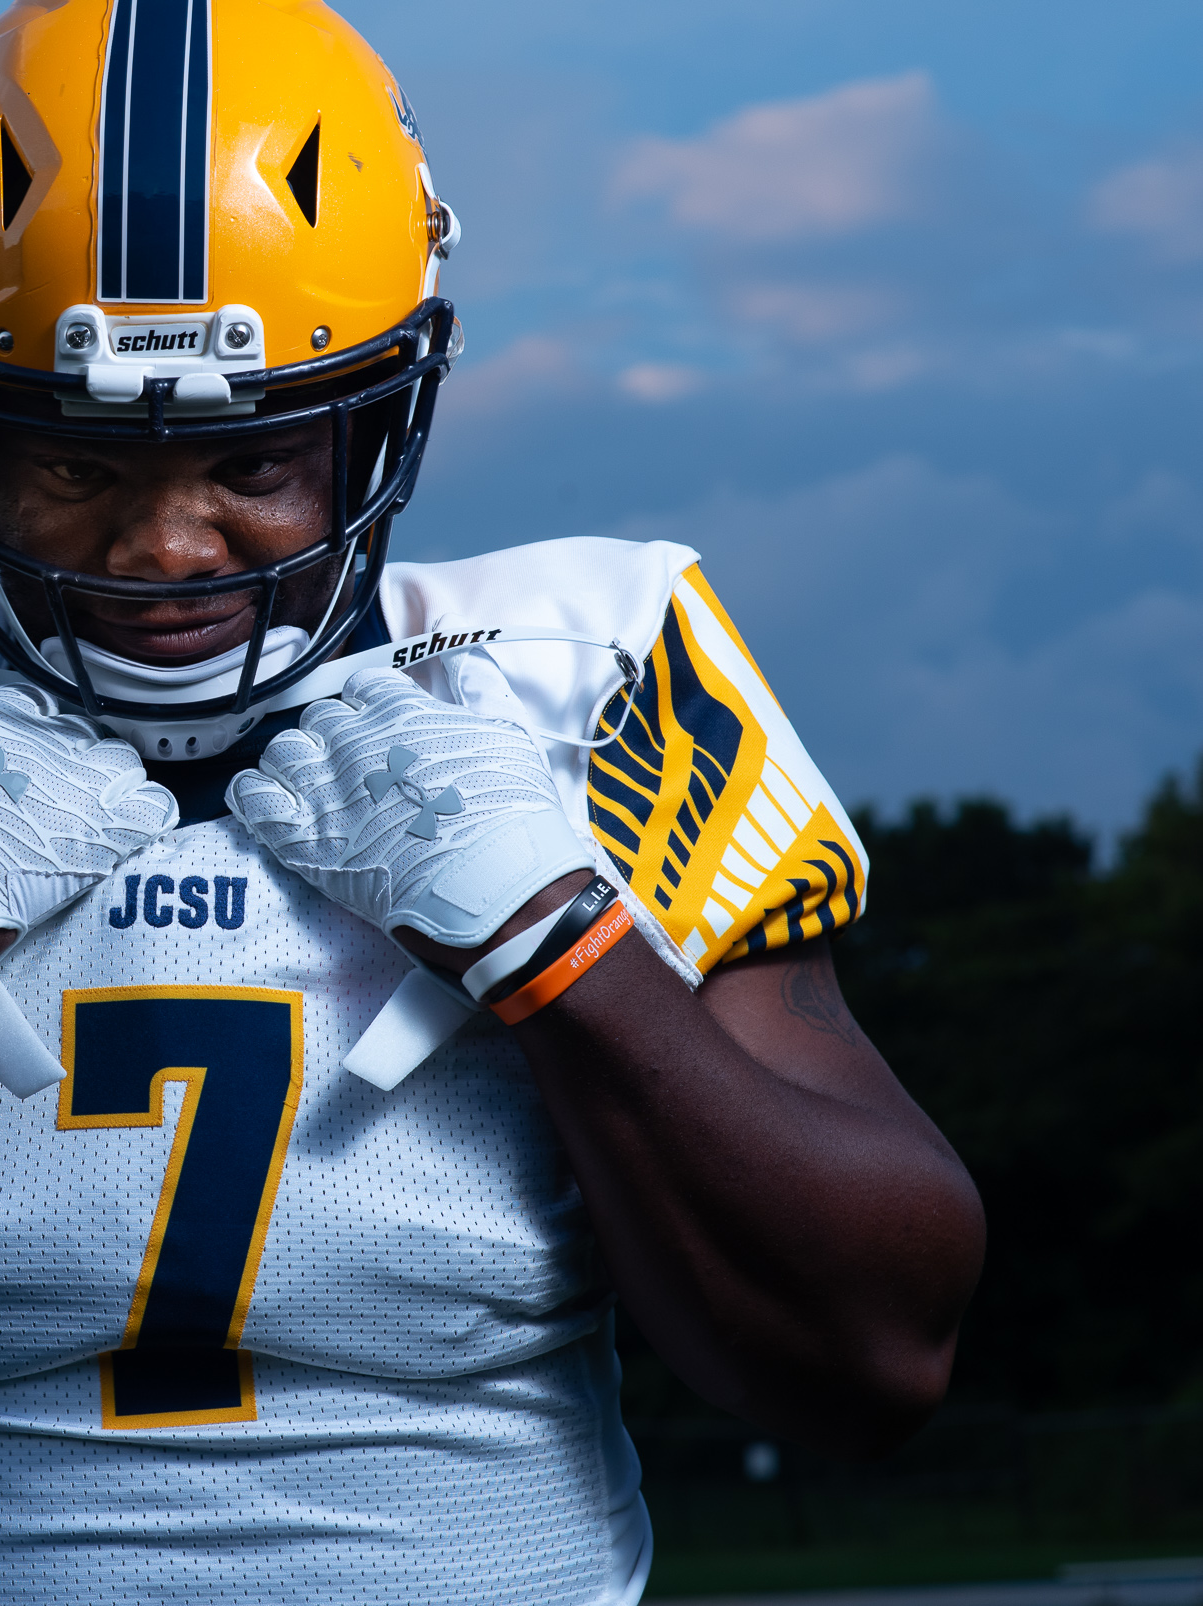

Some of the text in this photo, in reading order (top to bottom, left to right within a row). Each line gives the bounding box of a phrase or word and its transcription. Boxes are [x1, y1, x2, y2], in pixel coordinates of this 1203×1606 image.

[116, 329, 199, 352] schutt
[391, 628, 503, 669] schutt
[109, 874, 248, 930] JCSU
[57, 984, 303, 1430] 7
